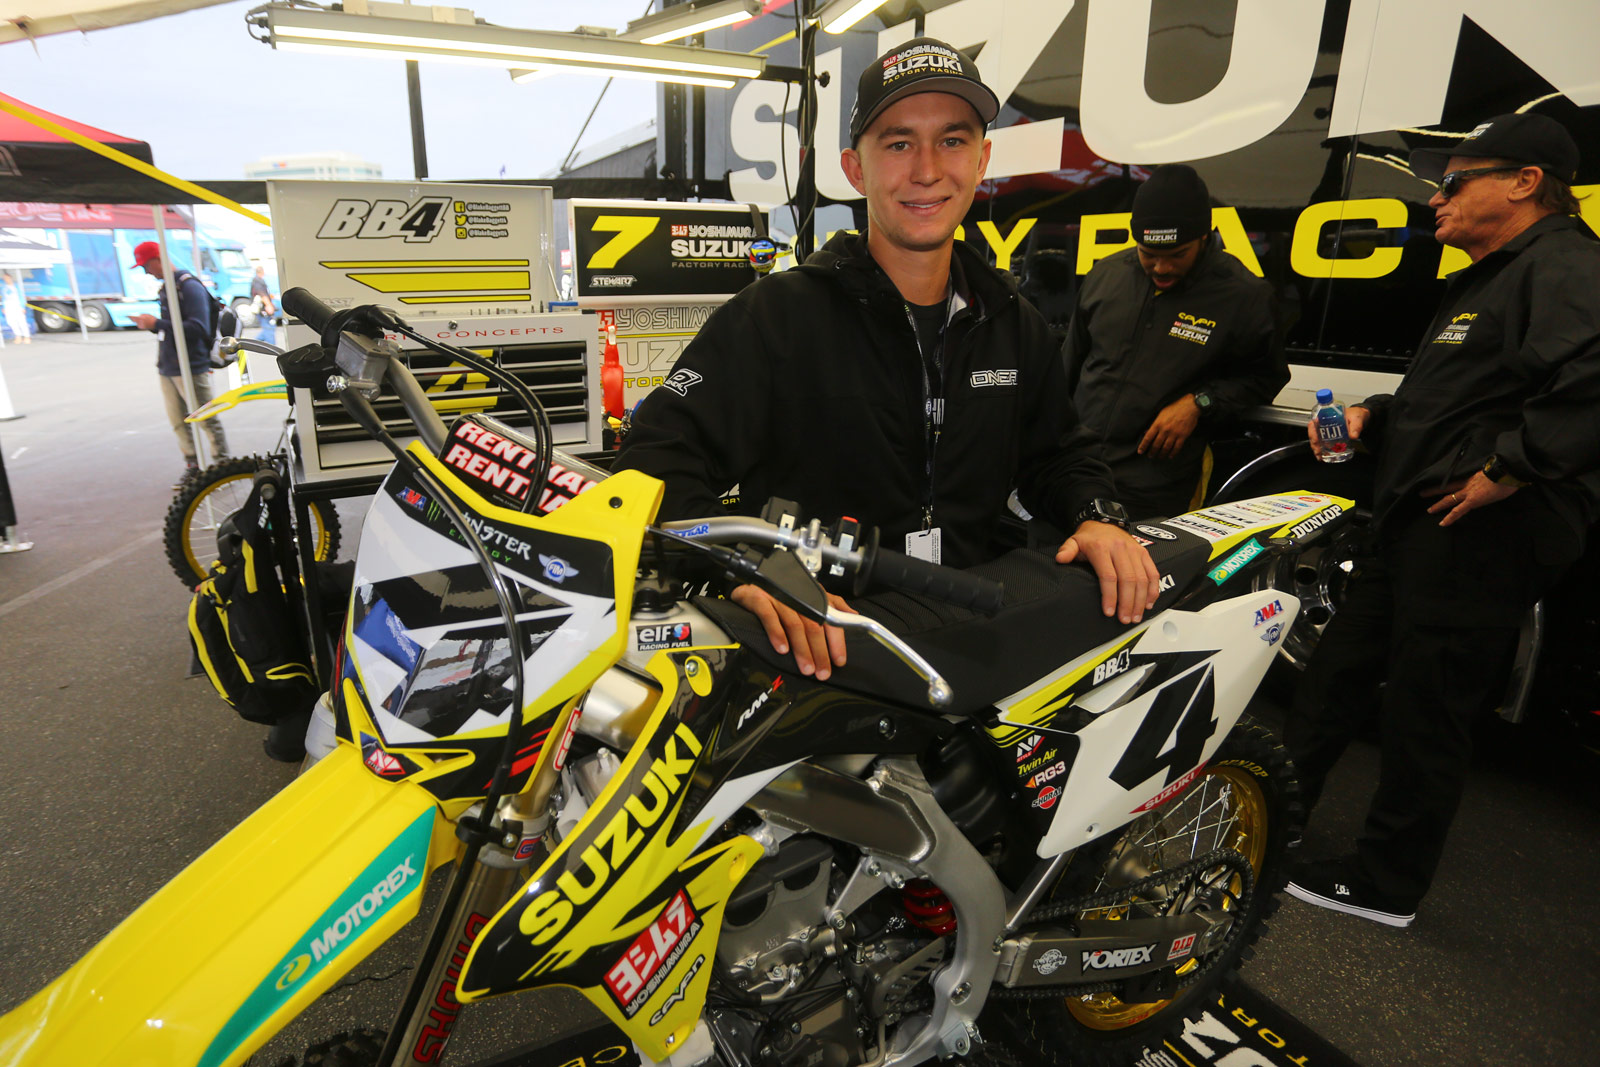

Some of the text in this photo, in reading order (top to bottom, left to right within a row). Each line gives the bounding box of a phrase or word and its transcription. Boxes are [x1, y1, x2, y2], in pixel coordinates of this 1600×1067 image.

[883, 55, 963, 80] SUZUKI
[883, 67, 927, 86] FACTORY
[316, 196, 452, 243] BB4
[586, 215, 661, 269] 7
[671, 239, 752, 258] SUZUK
[437, 327, 564, 338] CONCEPTS
[1170, 326, 1209, 342] SUZUKI
[1320, 425, 1341, 439] FIJI
[396, 486, 428, 512] AMA
[1290, 504, 1343, 539] DUNLOP
[547, 563, 565, 576] FIM
[1223, 542, 1261, 575] MOTOREX
[1254, 600, 1284, 627] AMA
[639, 625, 672, 643] elf
[640, 643, 670, 651] RACING
[1092, 648, 1130, 686] BB4
[1109, 662, 1219, 792] 4
[1017, 758, 1042, 775] Twin
[1042, 748, 1058, 763] Air
[1035, 760, 1066, 786] RG3
[1144, 771, 1195, 810] SUZUKI
[519, 722, 703, 946] SUZUKI
[310, 856, 417, 961] MOTOREX
[627, 923, 700, 1015] YOSHIMURA
[1083, 943, 1157, 971] VORTEX
